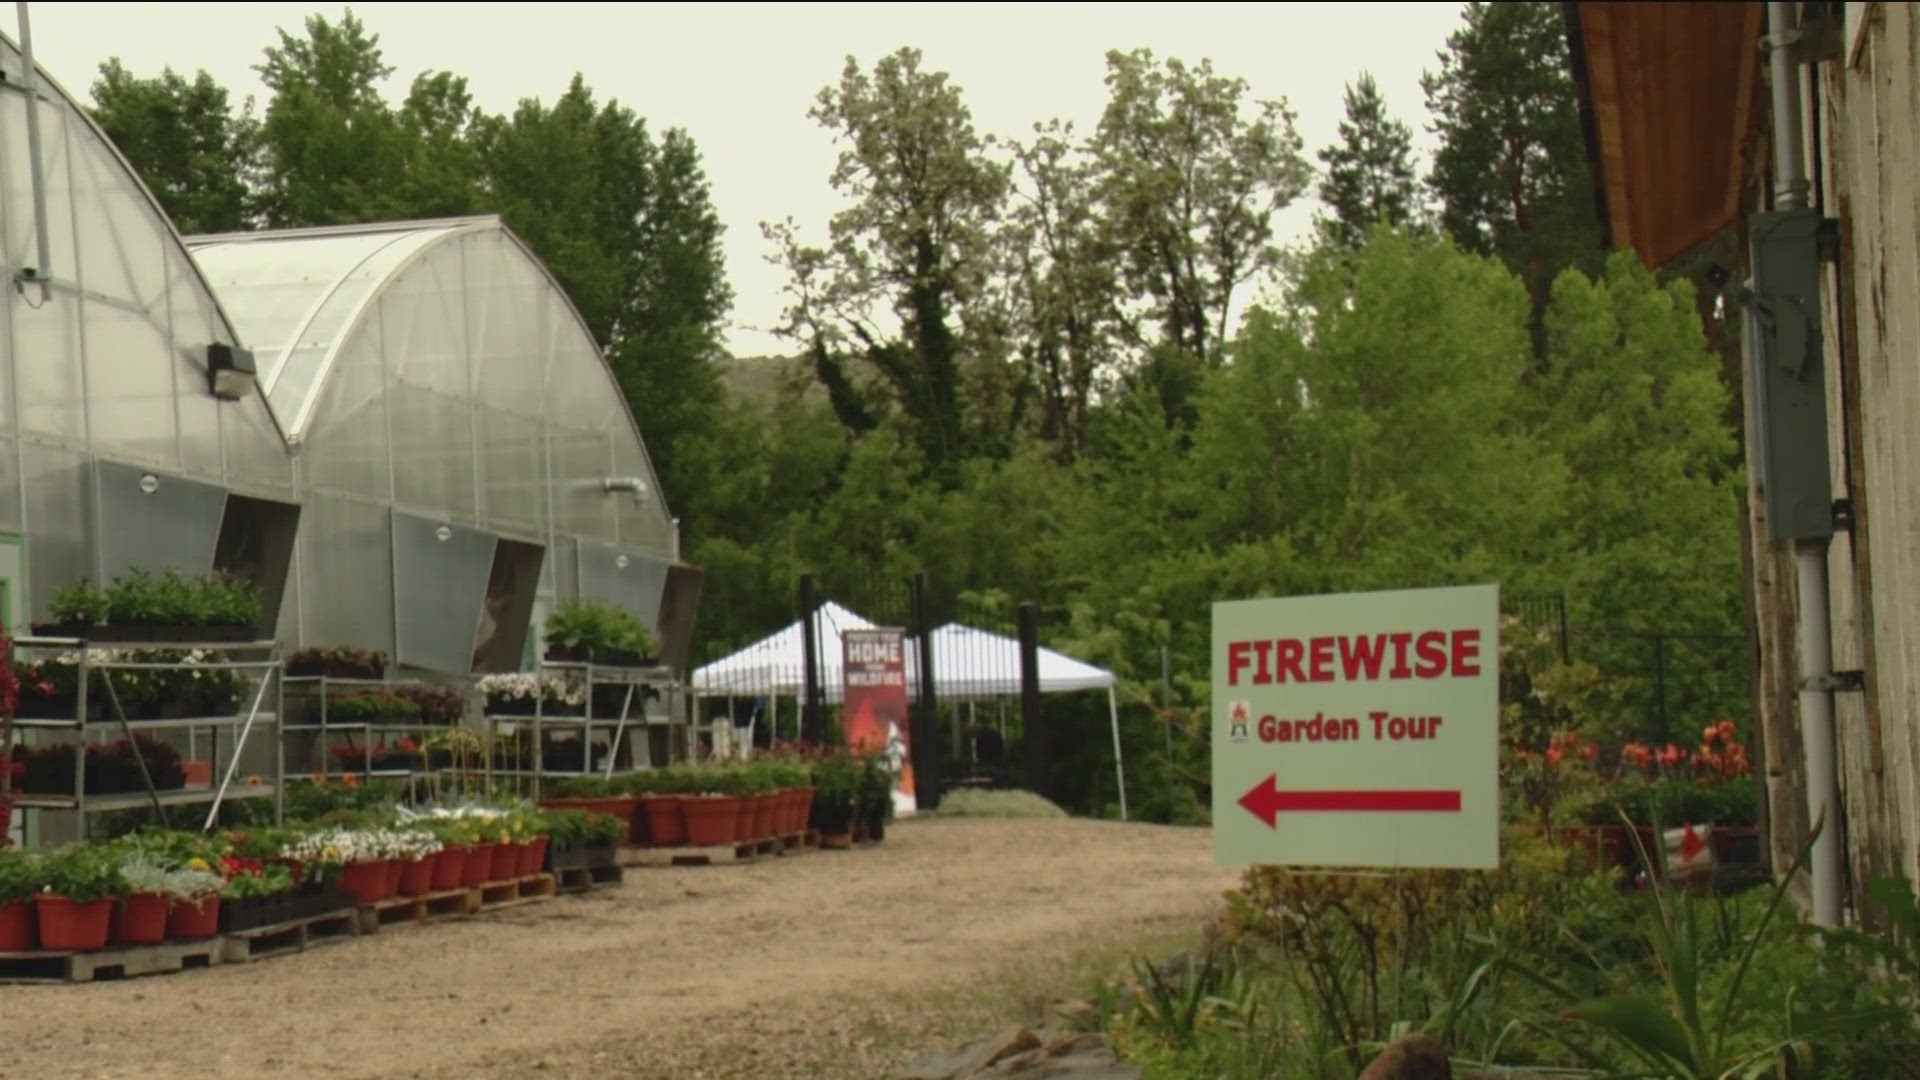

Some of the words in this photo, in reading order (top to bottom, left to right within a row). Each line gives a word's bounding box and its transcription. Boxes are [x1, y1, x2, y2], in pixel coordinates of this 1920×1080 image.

[848, 643, 901, 663] HOME
[1228, 629, 1481, 686] FIREWISE
[1258, 712, 1359, 743] Garden
[1369, 711, 1443, 740] Tour
